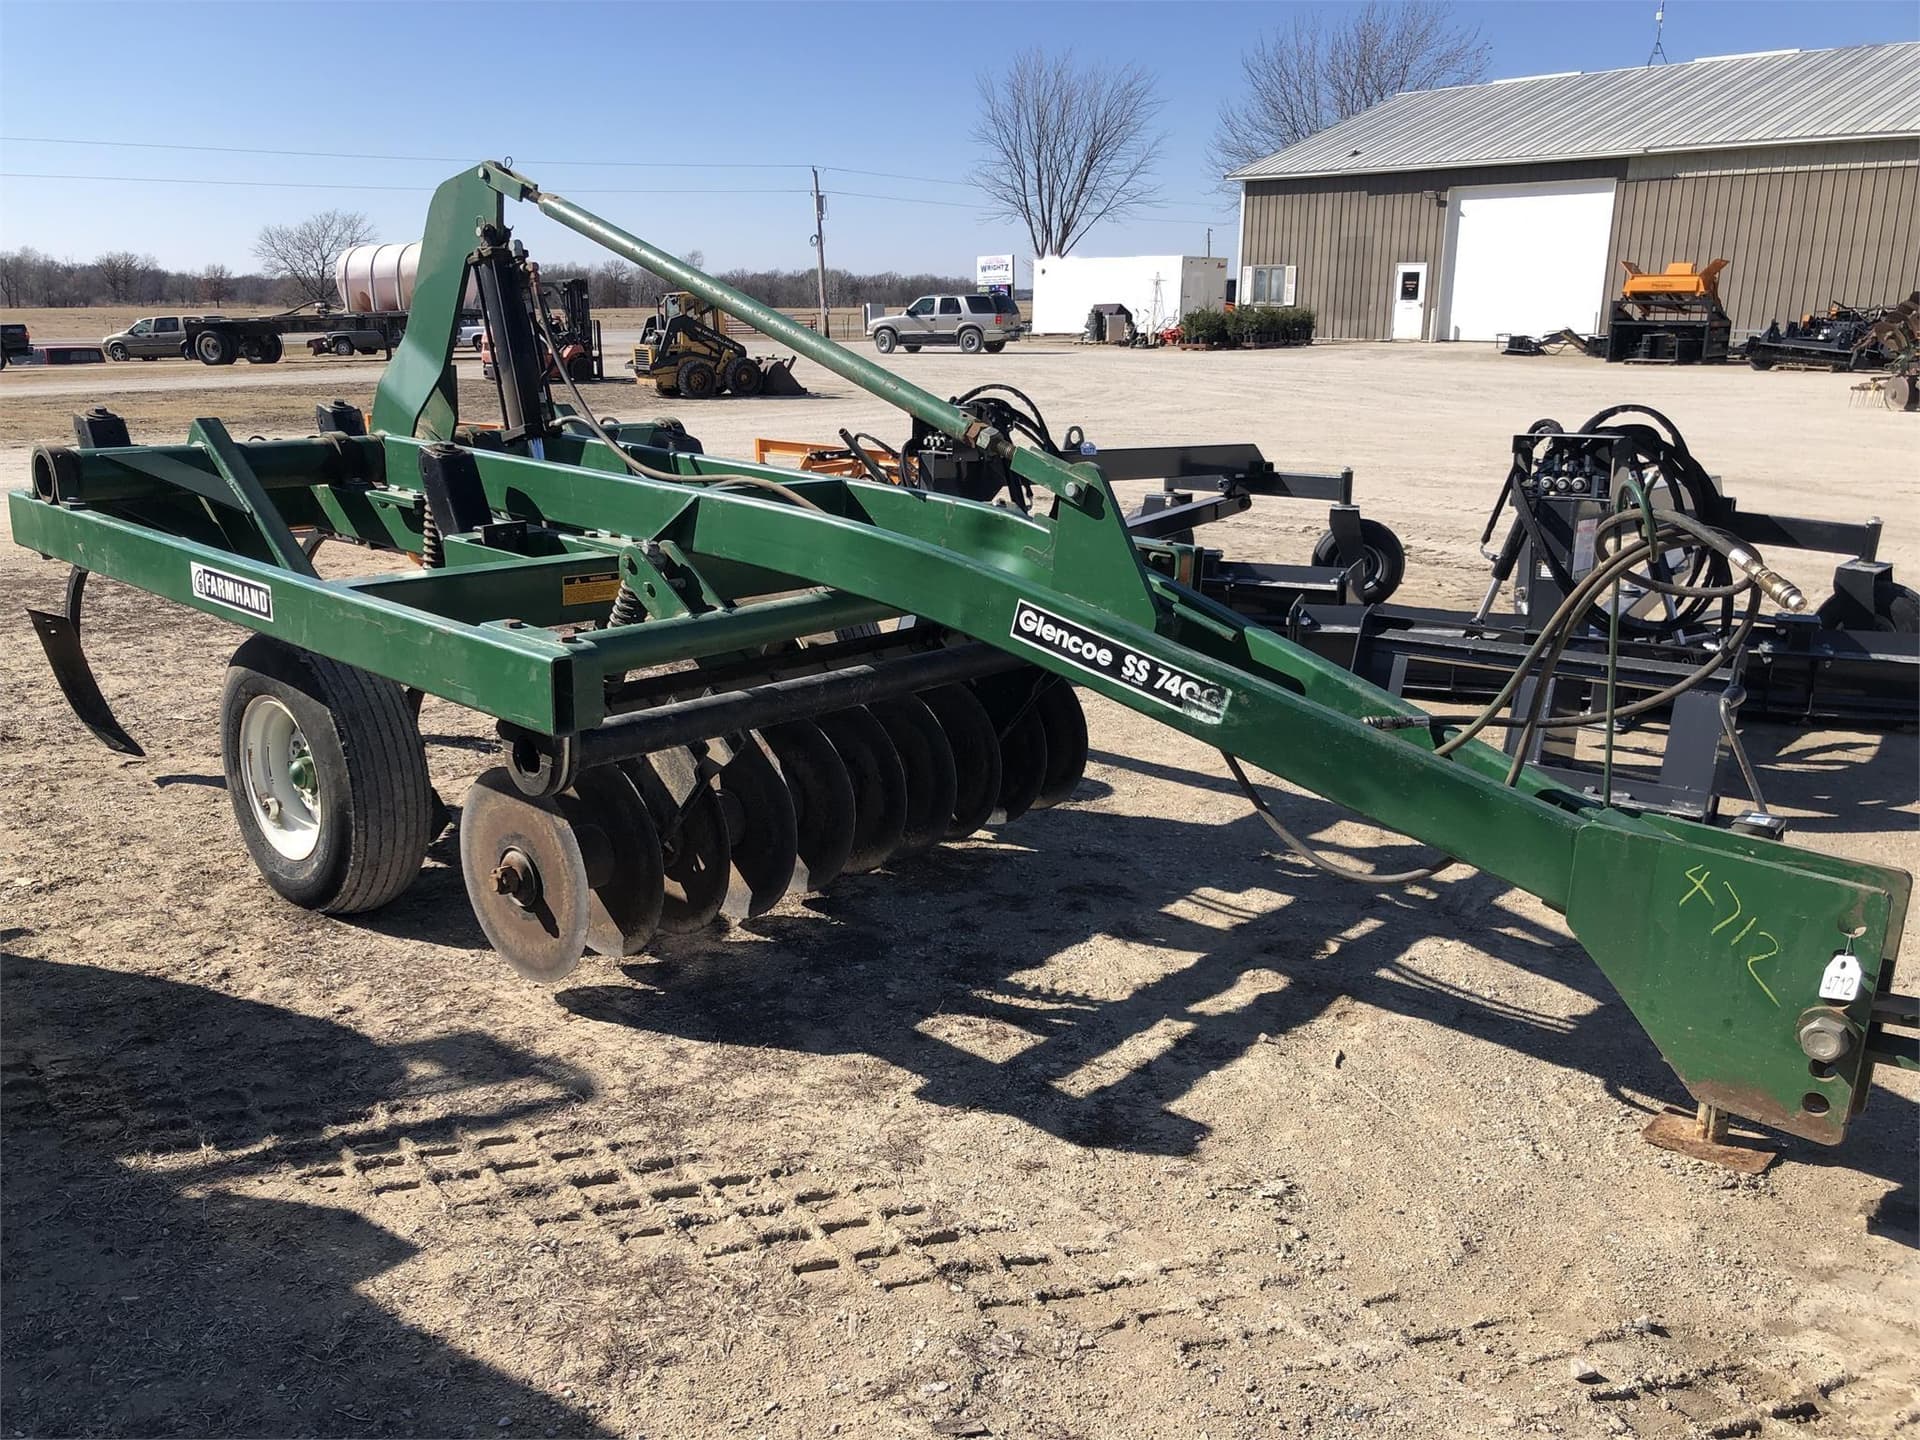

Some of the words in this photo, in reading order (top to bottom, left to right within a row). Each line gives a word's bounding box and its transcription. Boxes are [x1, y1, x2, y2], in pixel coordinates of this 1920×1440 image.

[204, 573, 268, 613] FARMHAND
[1018, 609, 1113, 667] Glencoe
[1121, 654, 1151, 682] SS
[1679, 864, 1781, 1008] 4712
[1825, 976, 1855, 996] 4712
